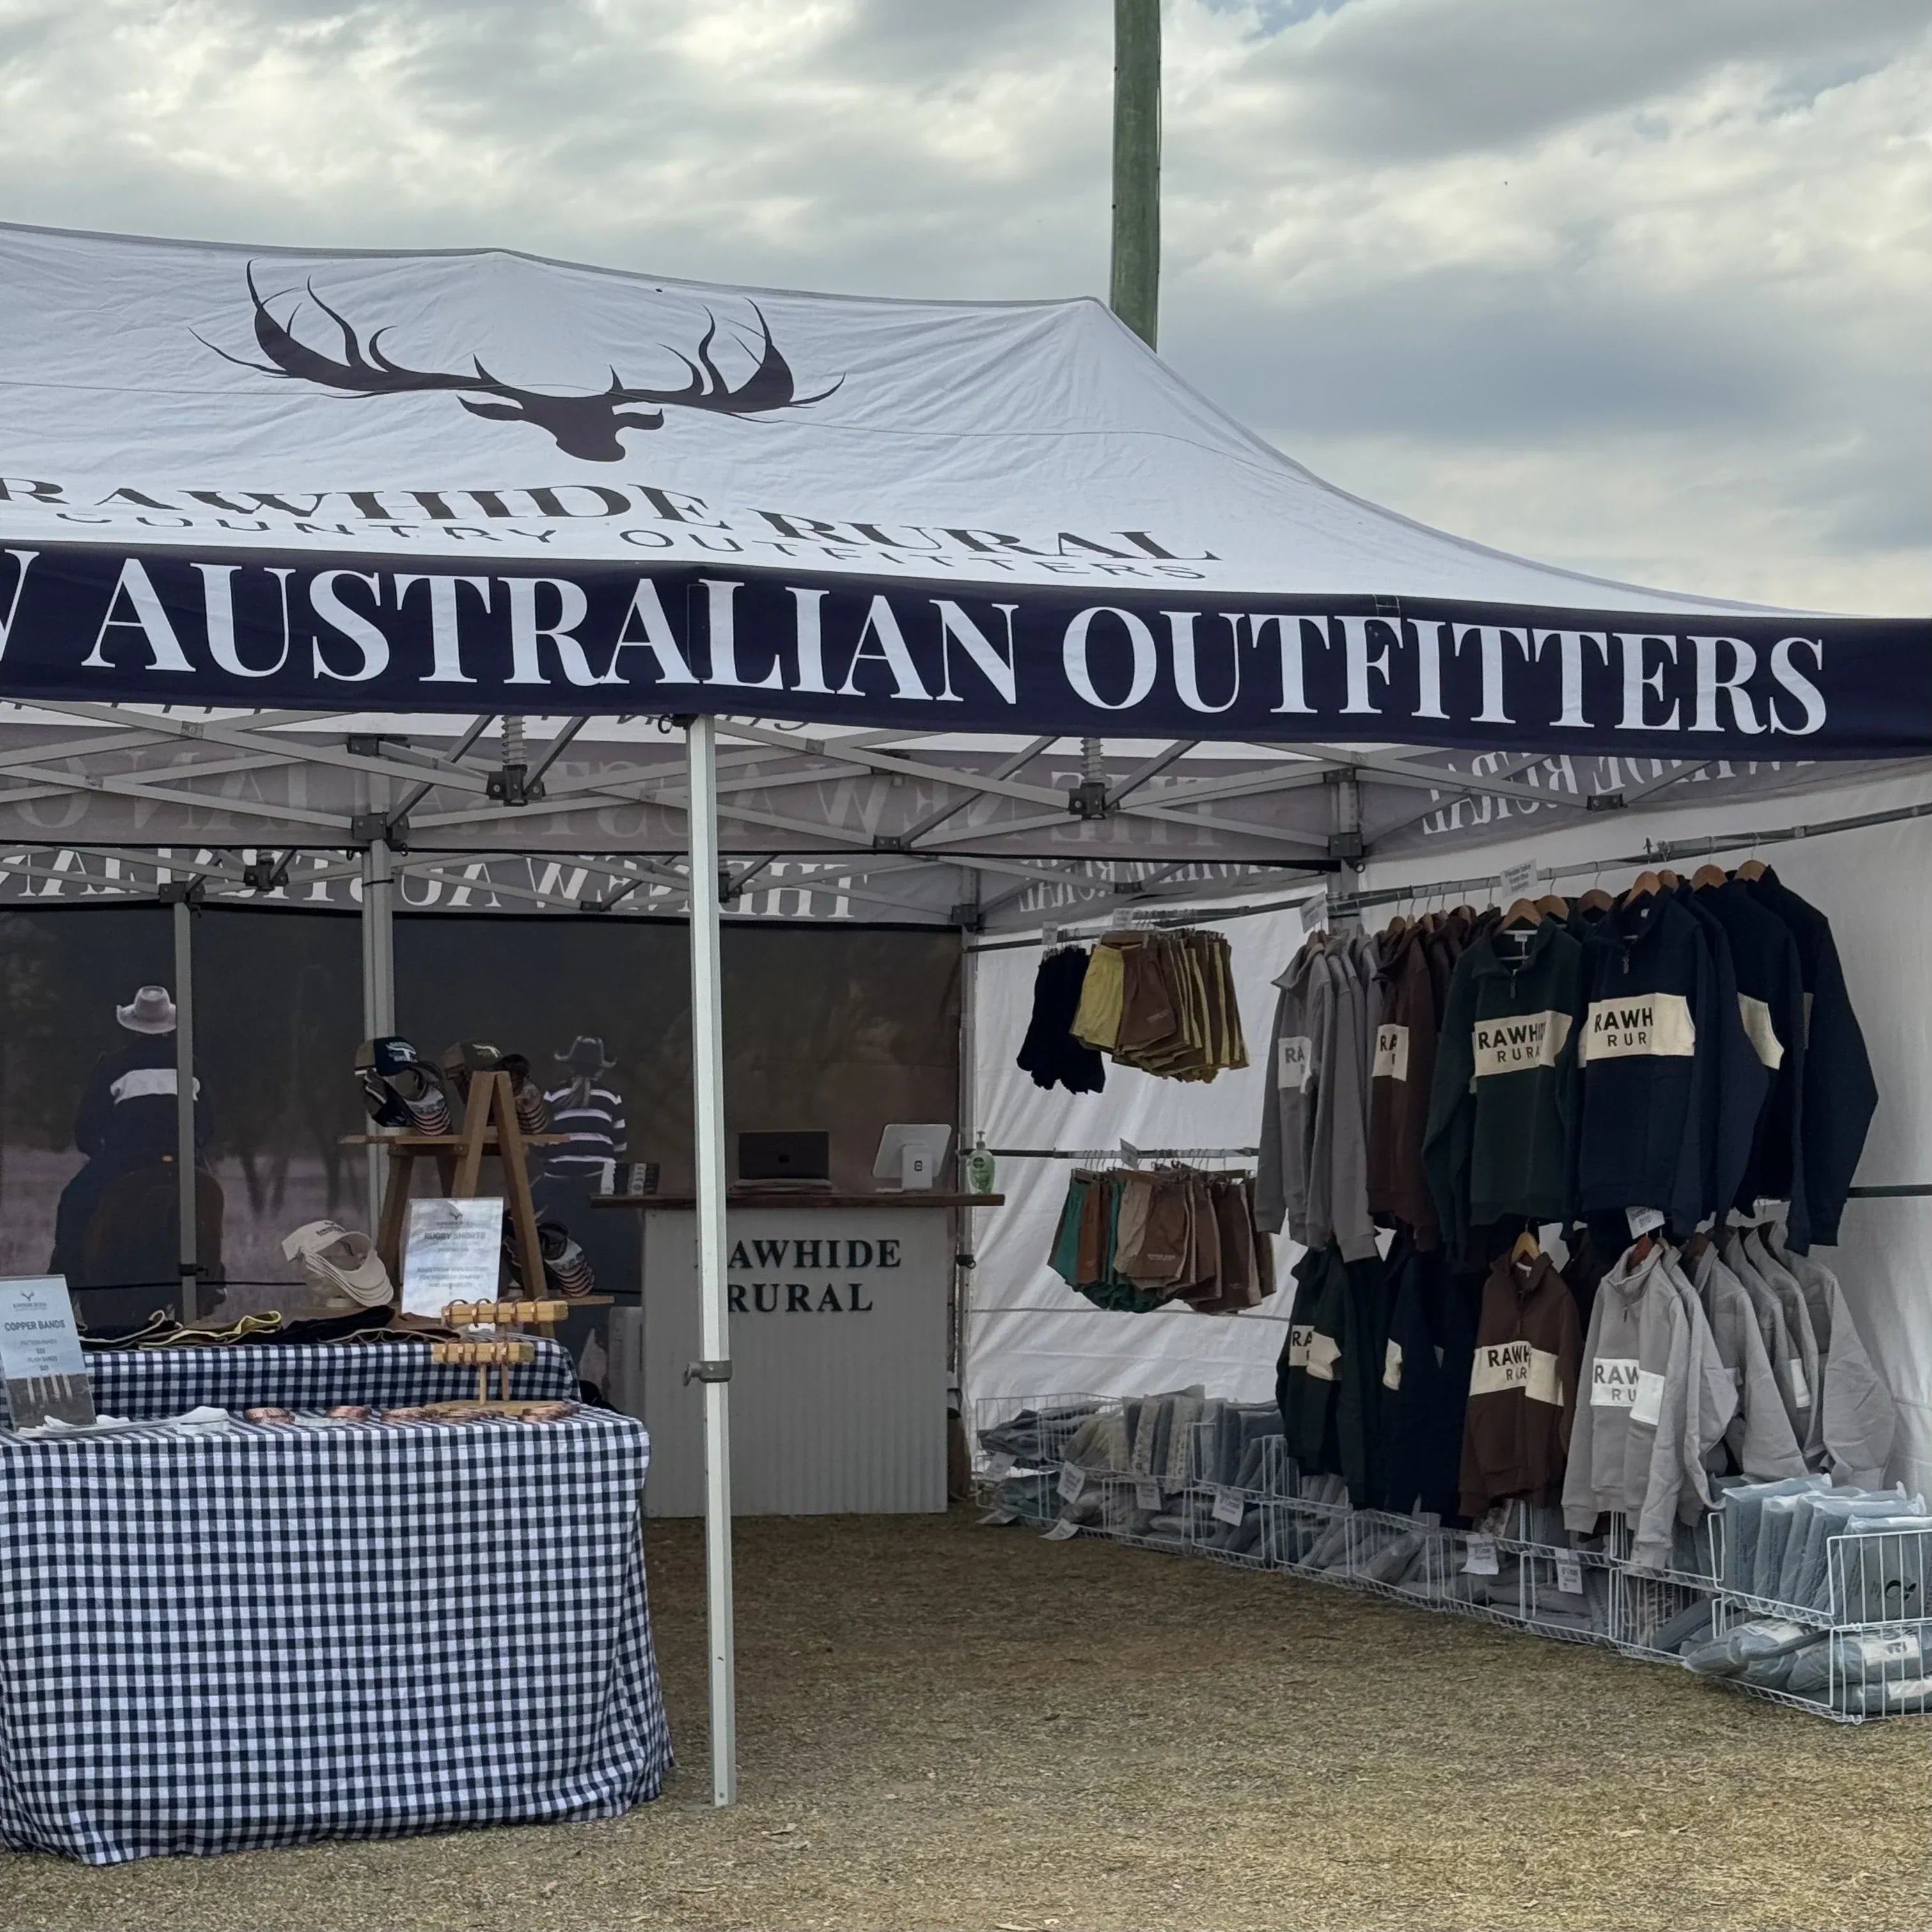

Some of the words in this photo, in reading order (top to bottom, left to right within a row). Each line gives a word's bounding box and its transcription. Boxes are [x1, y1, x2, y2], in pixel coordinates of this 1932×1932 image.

[0, 478, 728, 530] RAWHIDE
[746, 507, 1220, 561] RURAL
[619, 530, 1206, 580] OUTFITTERS
[81, 558, 1019, 705] AUSTRALIAN
[1062, 605, 1827, 735] OUTFITTERS
[1594, 1007, 1653, 1033] RAWH
[1607, 1032, 1647, 1048] RUR
[695, 1239, 901, 1269] AWHIDE
[728, 1283, 873, 1312] RURAL
[4, 1320, 36, 1331] COPPER
[38, 1319, 66, 1330] BANDS
[1612, 1388, 1637, 1402] RU
